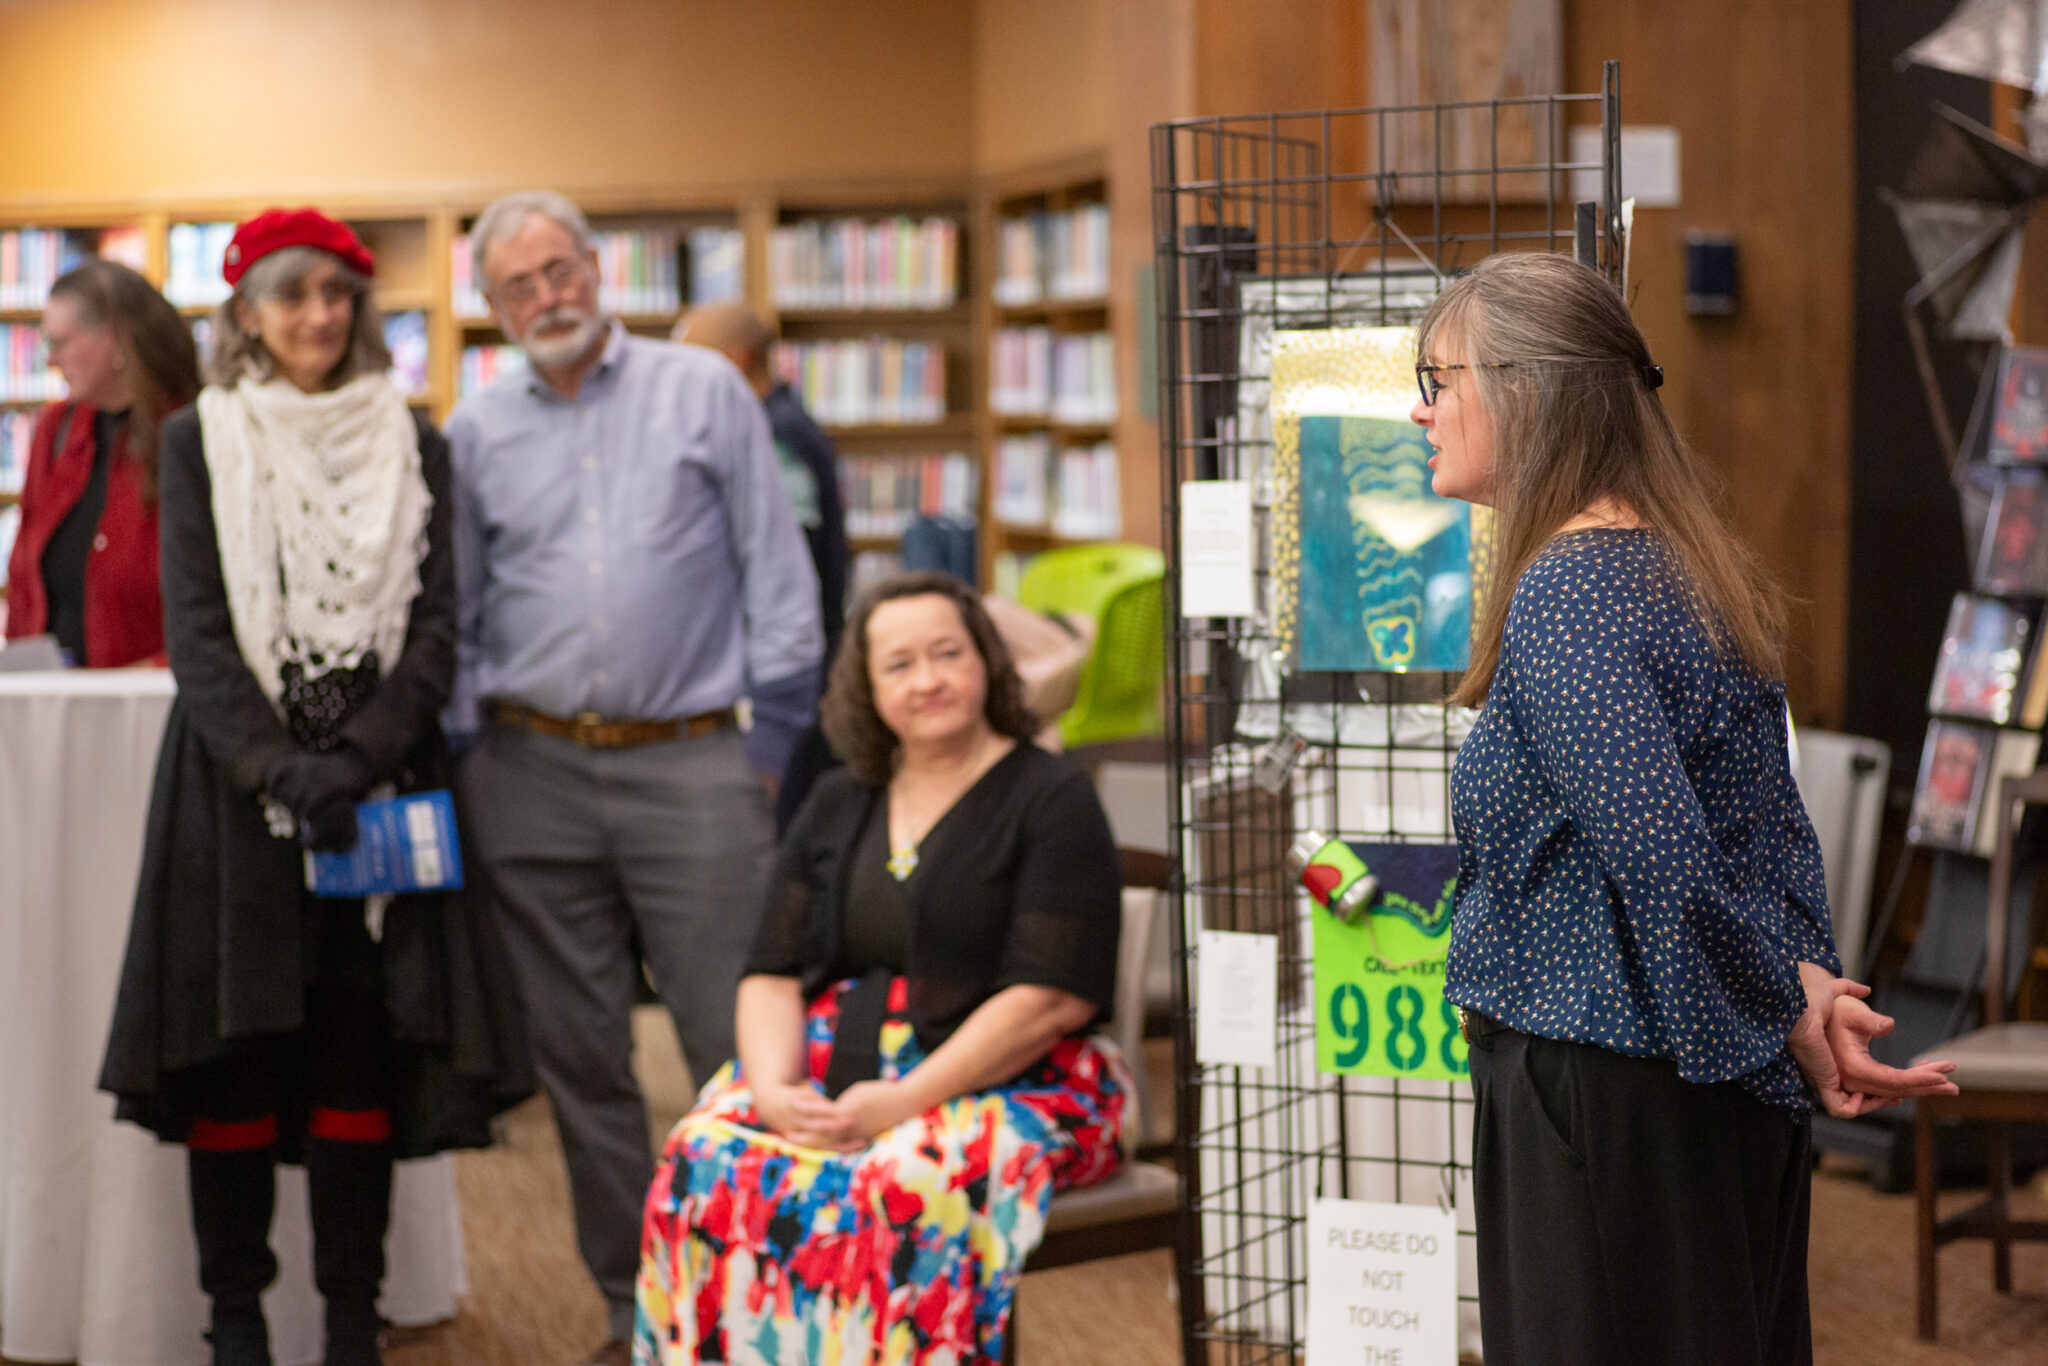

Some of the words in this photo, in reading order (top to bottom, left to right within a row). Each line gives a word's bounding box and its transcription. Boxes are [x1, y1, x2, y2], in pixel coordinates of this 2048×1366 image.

[1328, 1227, 1401, 1253] PLEASE
[1407, 1233, 1438, 1256] DO
[1362, 1269, 1404, 1291] NOT
[1348, 1305, 1420, 1331] TOUCH
[1365, 1345, 1403, 1366] THE
